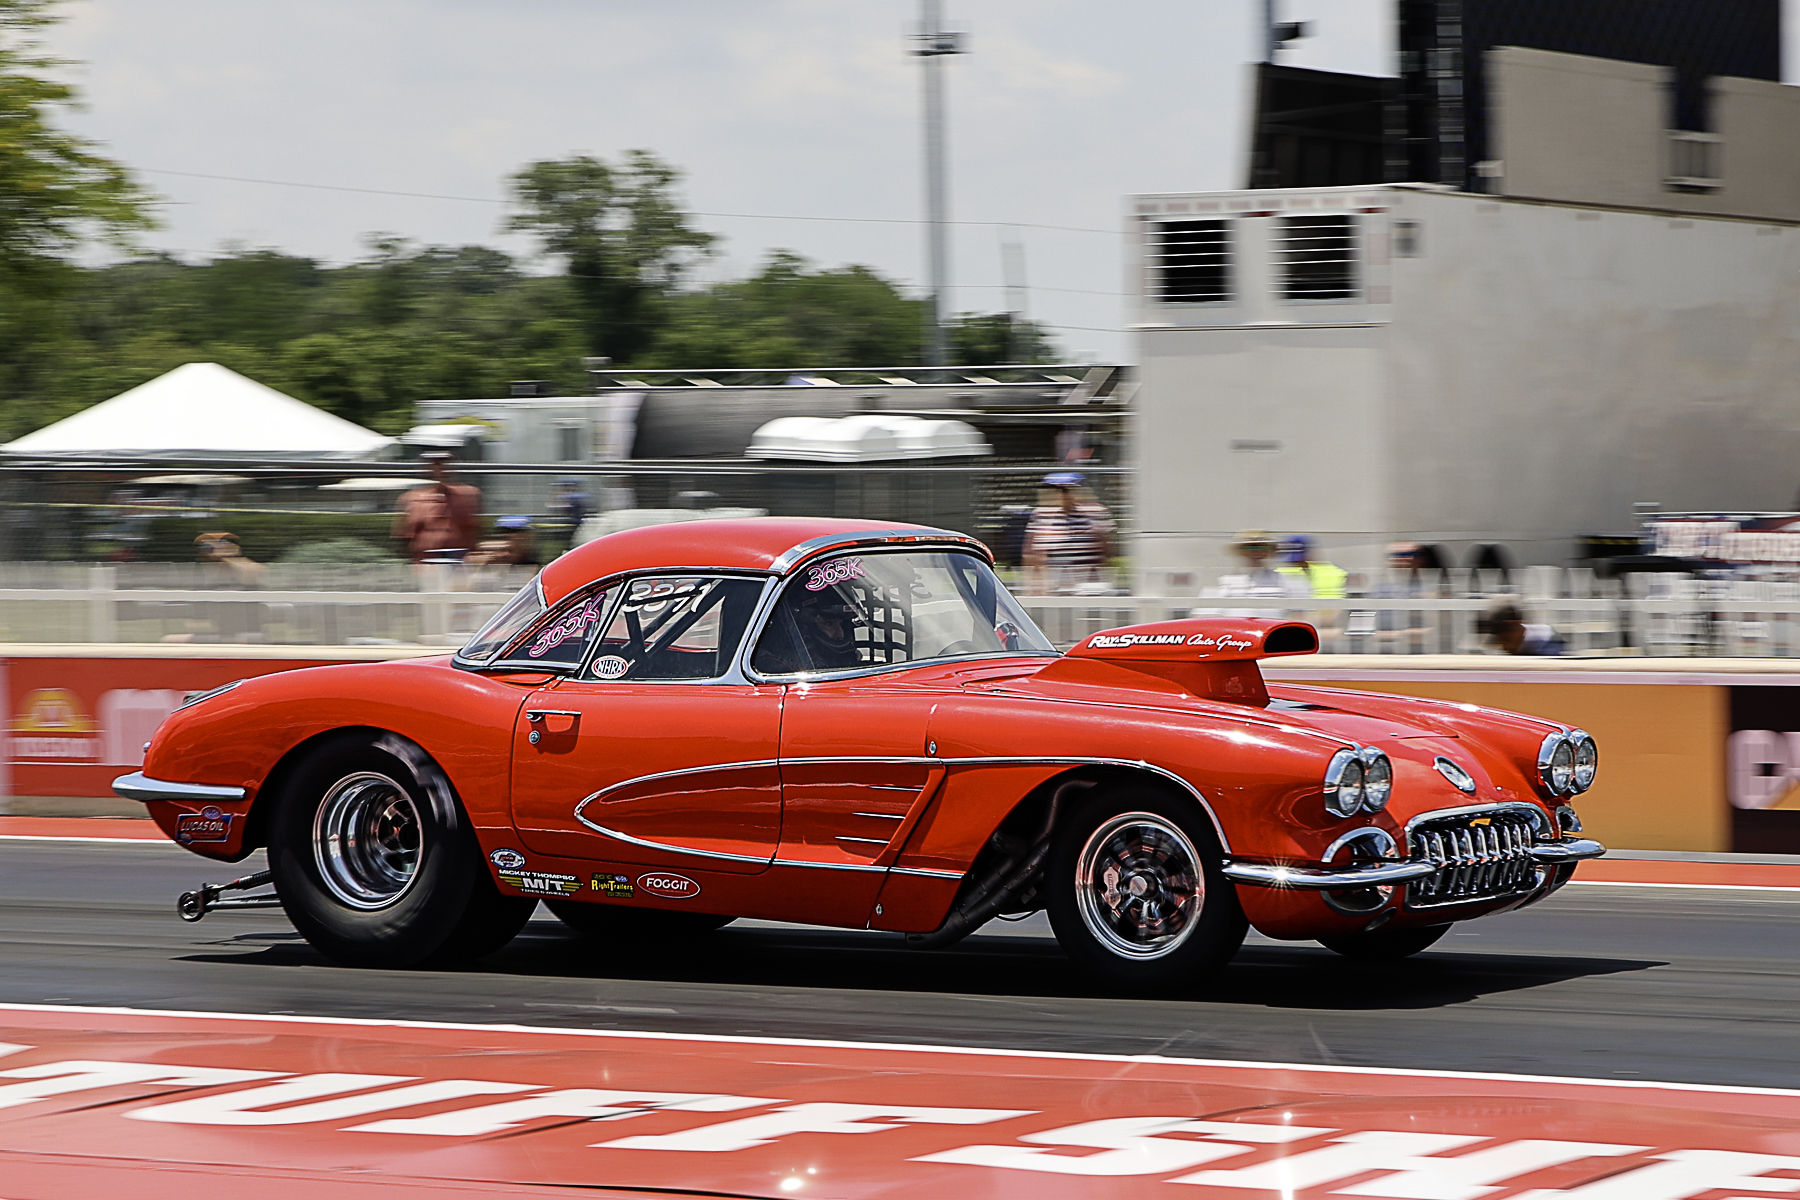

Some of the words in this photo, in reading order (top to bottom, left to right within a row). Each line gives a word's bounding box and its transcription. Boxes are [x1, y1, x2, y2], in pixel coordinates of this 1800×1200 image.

[805, 557, 867, 591] 365K
[529, 591, 608, 658] 365K
[1088, 636, 1117, 648] RAY
[1115, 634, 1186, 648] SKILLMAN
[1187, 634, 1216, 646] Auto
[1216, 634, 1252, 651] Group
[598, 660, 623, 675] NHRA
[180, 821, 210, 831] LUCAS
[209, 821, 224, 831] OIL
[499, 869, 531, 877] MICKEY
[646, 877, 690, 891] FOGGIT
